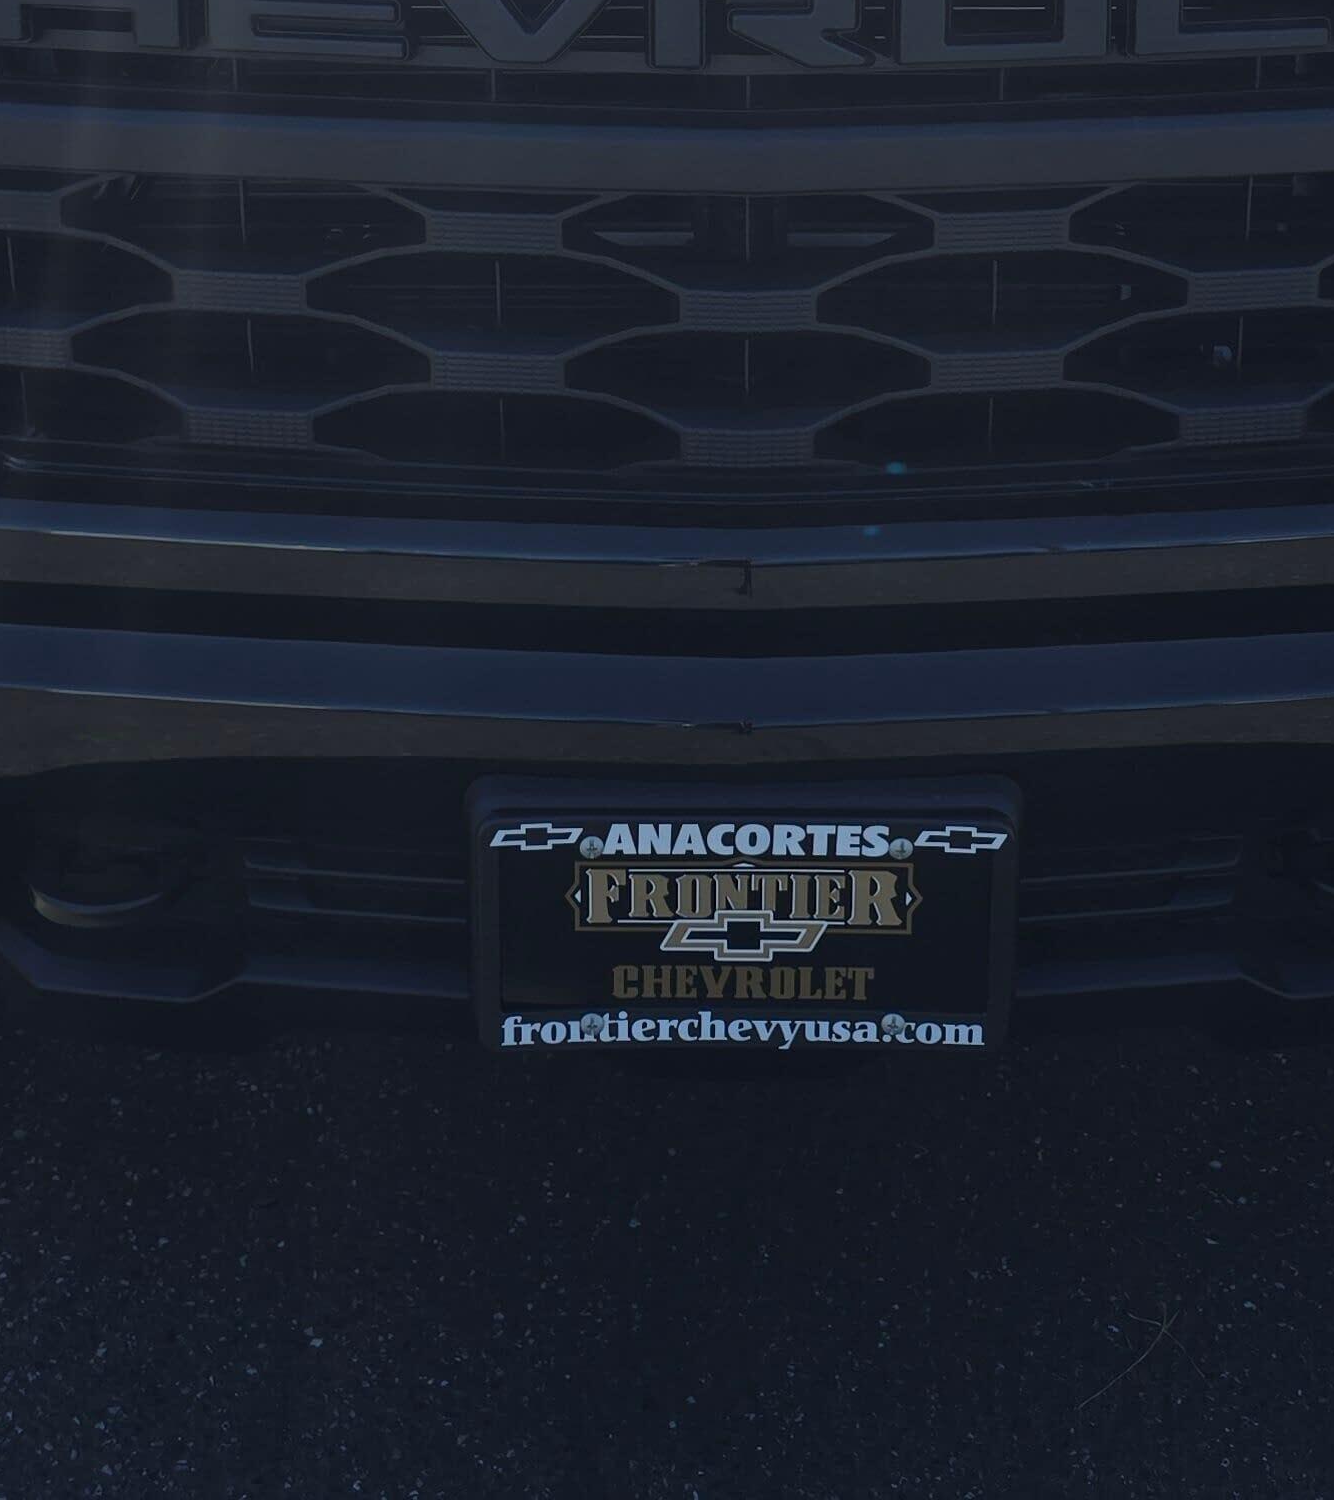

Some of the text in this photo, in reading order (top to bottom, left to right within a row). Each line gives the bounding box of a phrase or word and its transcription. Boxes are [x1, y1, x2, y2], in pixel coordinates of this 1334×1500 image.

[604, 823, 889, 858] ANACORTES
[585, 868, 903, 927] FRONTIER
[611, 965, 875, 1001] CHEVROLET
